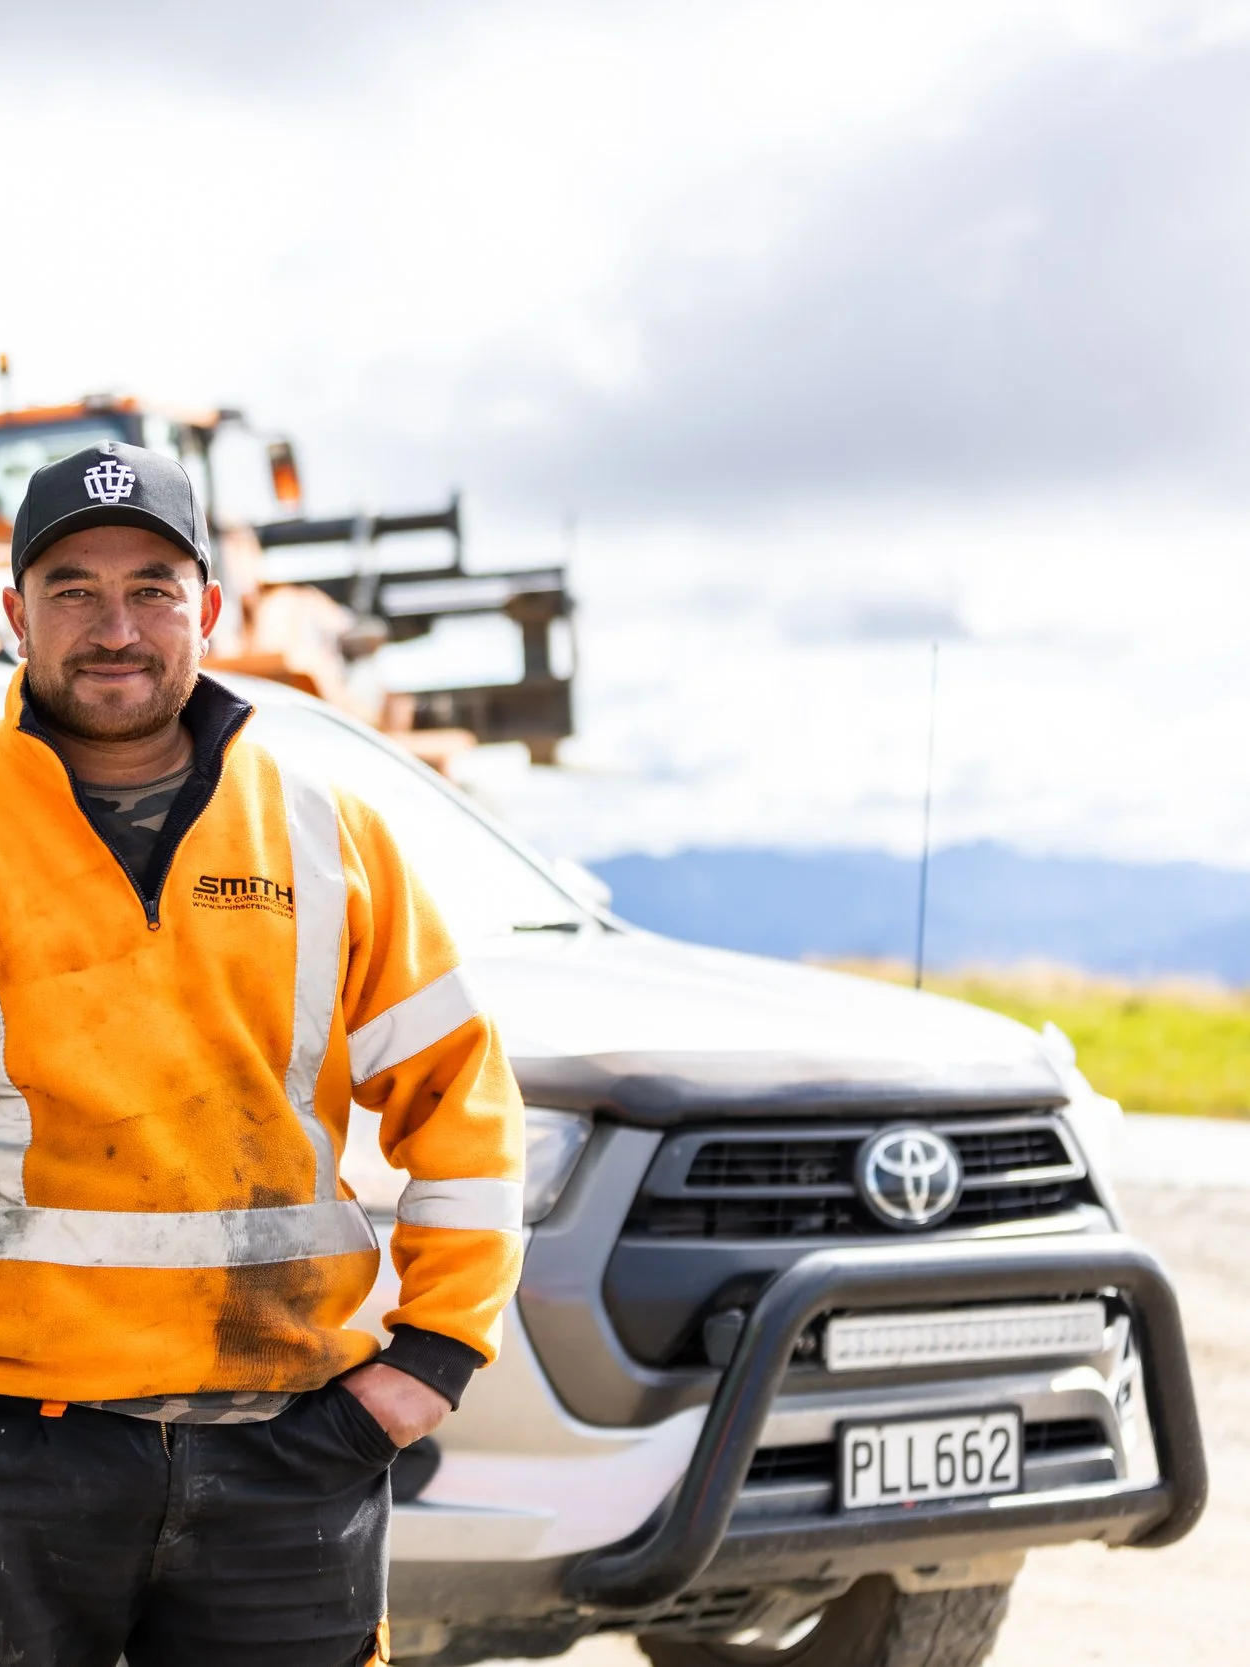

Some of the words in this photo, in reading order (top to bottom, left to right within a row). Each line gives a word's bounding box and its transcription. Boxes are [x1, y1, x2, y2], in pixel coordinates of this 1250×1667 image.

[192, 892, 220, 904] CRANE
[234, 894, 294, 913] CONSTRUCTION
[852, 1427, 1011, 1499] PLL662
